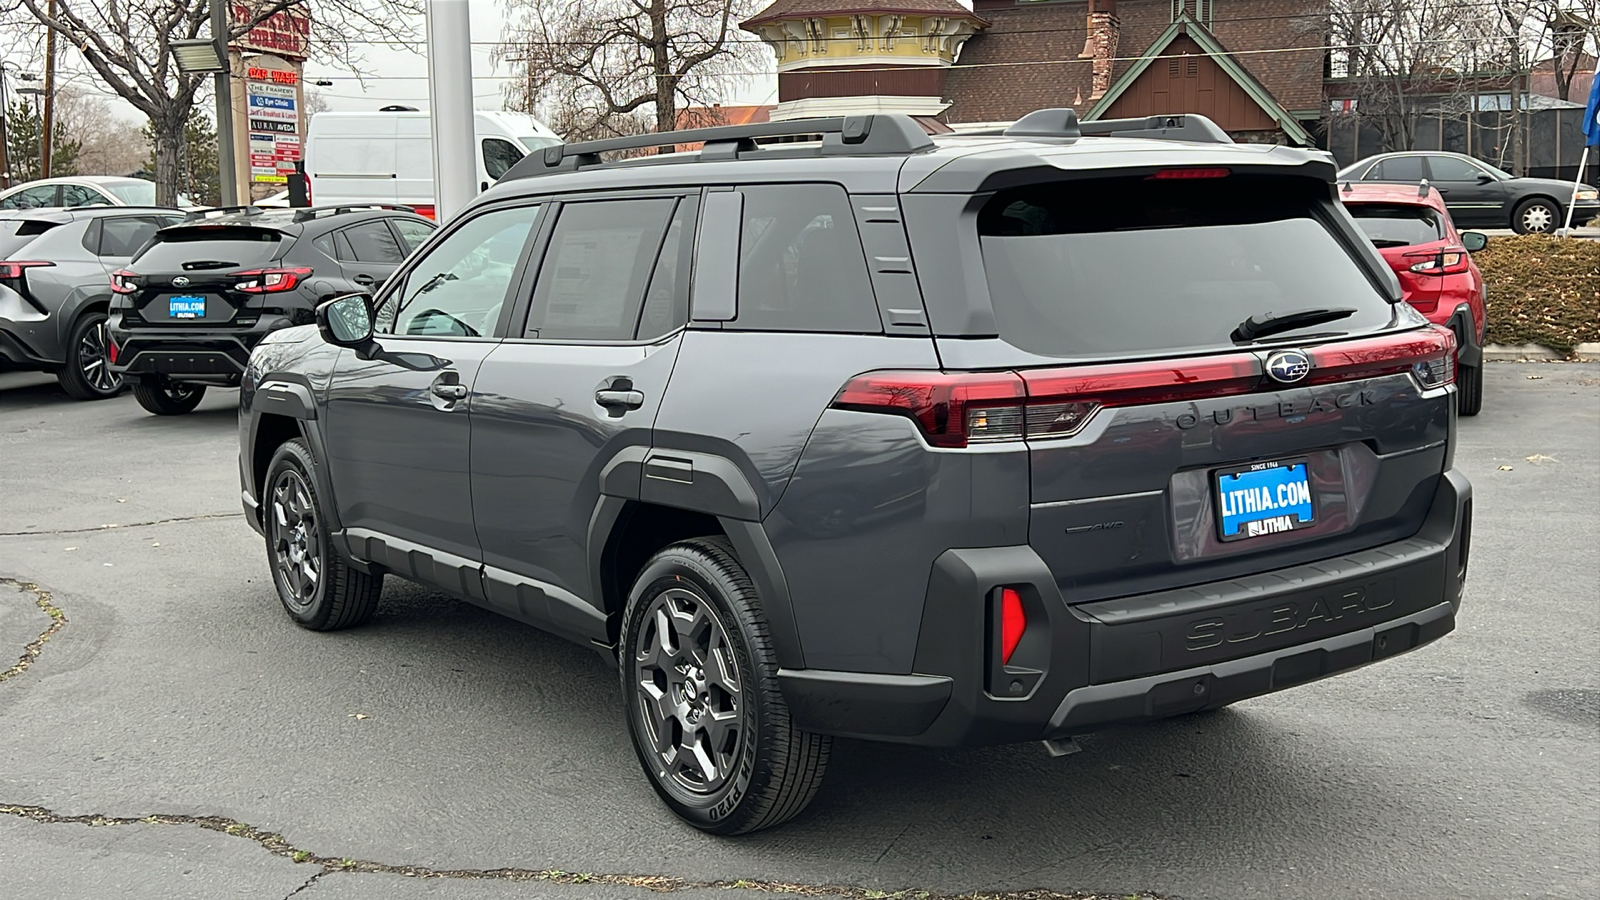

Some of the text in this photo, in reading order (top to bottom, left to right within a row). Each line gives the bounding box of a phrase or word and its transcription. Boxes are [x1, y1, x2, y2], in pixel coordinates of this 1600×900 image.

[248, 67, 298, 84] CAR WASH
[266, 86, 294, 94] FRAMERY
[265, 98, 289, 107] Eye Clinic
[262, 110, 281, 118] Breakfast
[252, 121, 295, 132] AURA AVEDA
[170, 302, 205, 312] LITHIA.COM
[1177, 390, 1377, 430] OUTBACK
[1251, 463, 1266, 471] SINCE
[1221, 479, 1311, 517] LITHIA.COM
[1258, 515, 1293, 535] LITHIA
[1185, 581, 1397, 651] SUBARU
